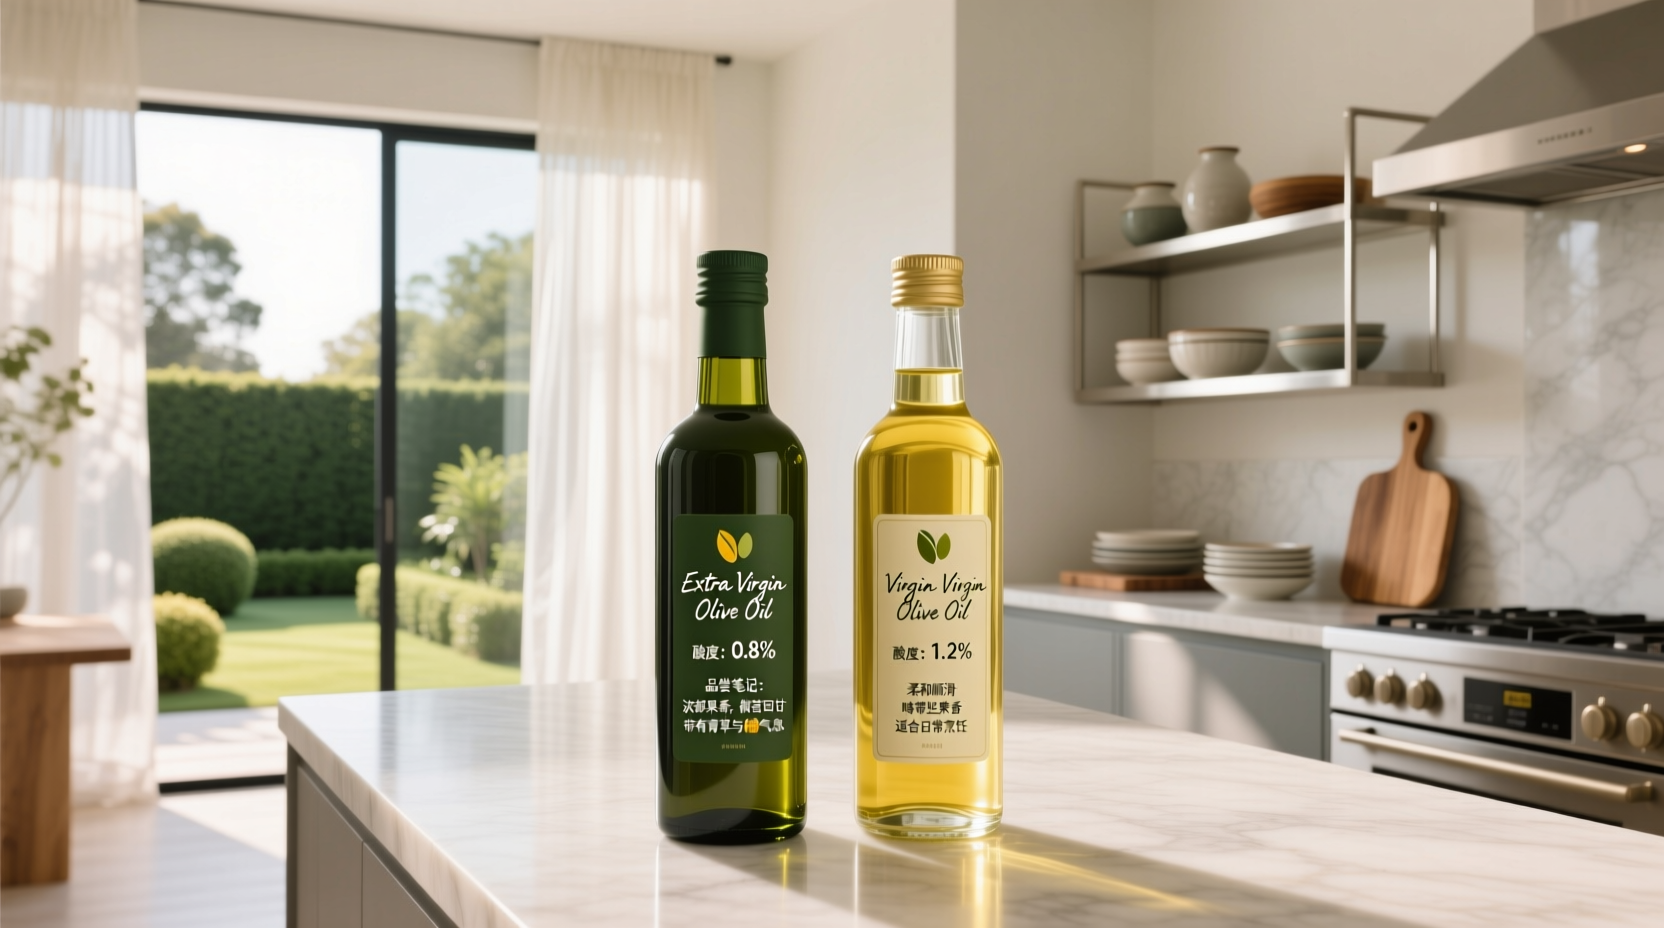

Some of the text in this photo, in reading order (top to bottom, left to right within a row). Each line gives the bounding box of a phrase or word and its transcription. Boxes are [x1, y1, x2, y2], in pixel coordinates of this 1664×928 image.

[681, 571, 787, 602] Extra Virgin
[885, 572, 987, 603] Virgin Virgin
[695, 597, 774, 621] Olive Oil
[896, 599, 972, 621] Olive Oil
[731, 640, 776, 659] 0.8%
[931, 642, 972, 660] 1.2%
